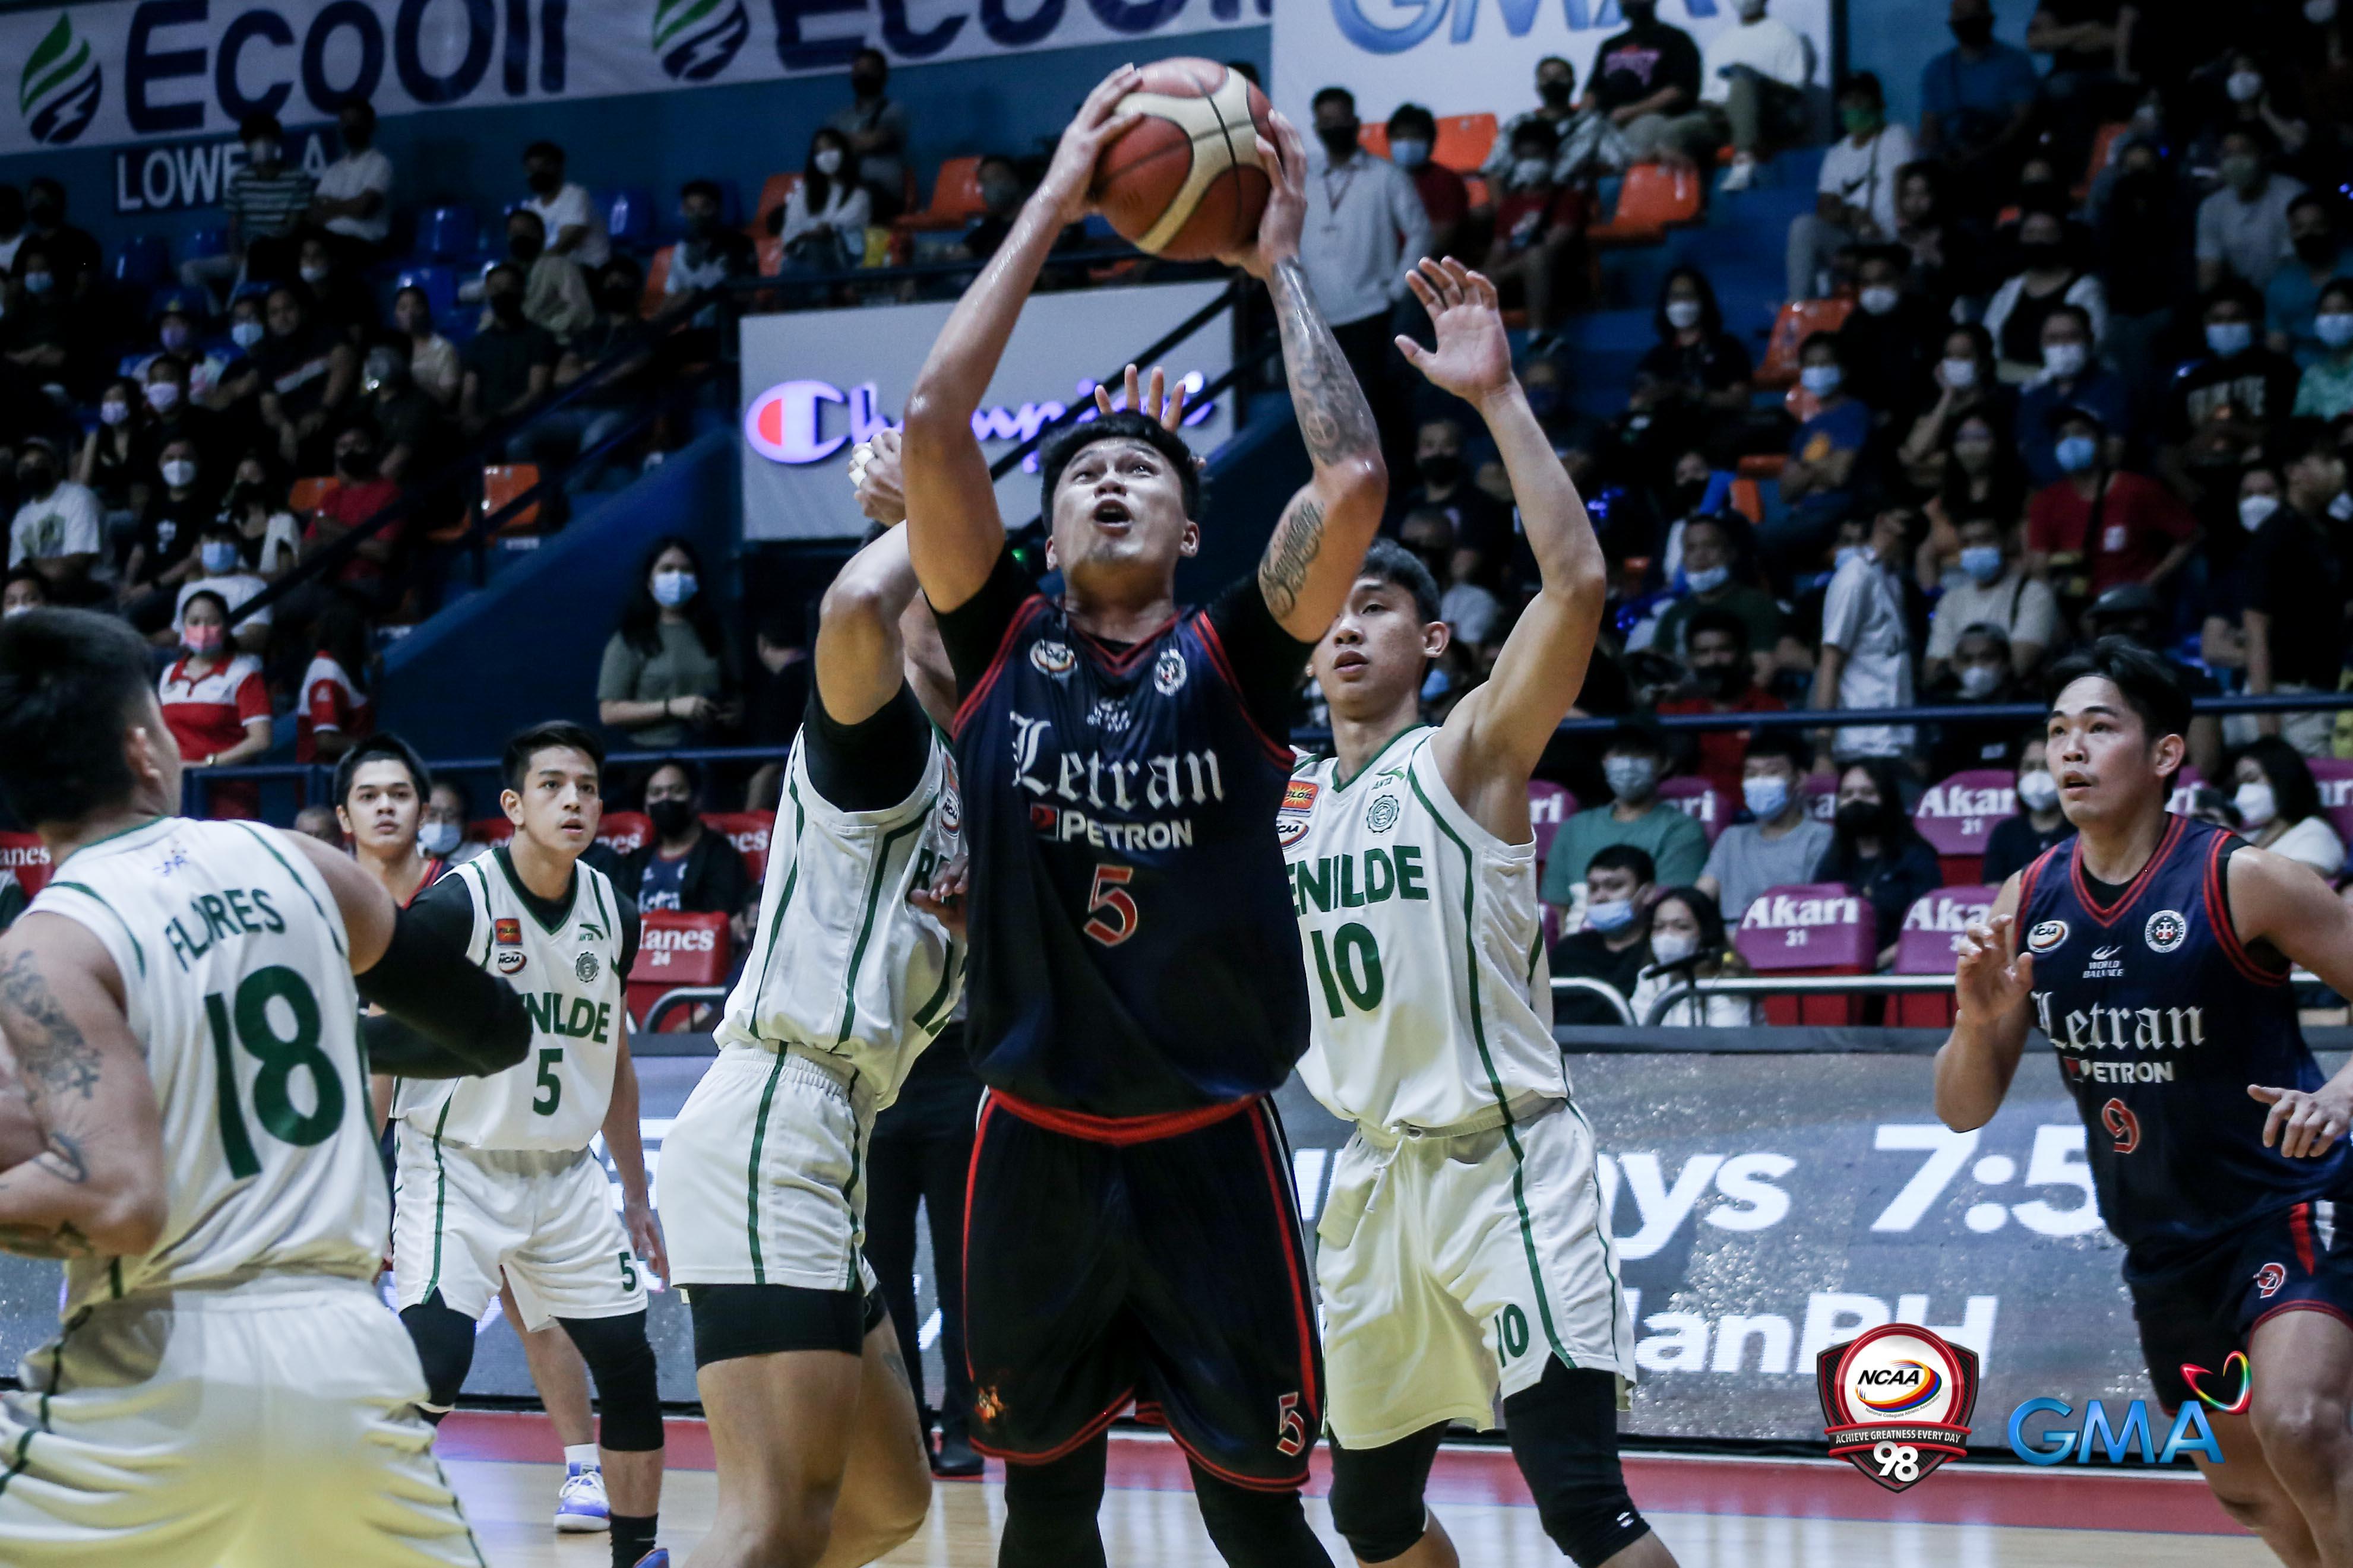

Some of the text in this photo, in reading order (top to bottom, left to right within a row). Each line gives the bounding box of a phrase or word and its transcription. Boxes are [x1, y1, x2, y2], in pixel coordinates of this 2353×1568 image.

[1010, 711, 1225, 811] Letran
[1062, 810, 1193, 851] PETRON
[1915, 784, 2017, 818] Akar
[1083, 864, 1138, 947] 5
[1741, 895, 1859, 929] Akari
[1311, 923, 1384, 1018] 10
[2030, 992, 2205, 1051] Letran
[205, 964, 344, 1179] 18
[532, 1048, 564, 1117] 5
[2080, 1059, 2174, 1084] PETRON
[2101, 1097, 2140, 1154] 9
[619, 1252, 637, 1292] 5
[1495, 1303, 1529, 1368] 10
[1277, 1391, 1305, 1457] 5
